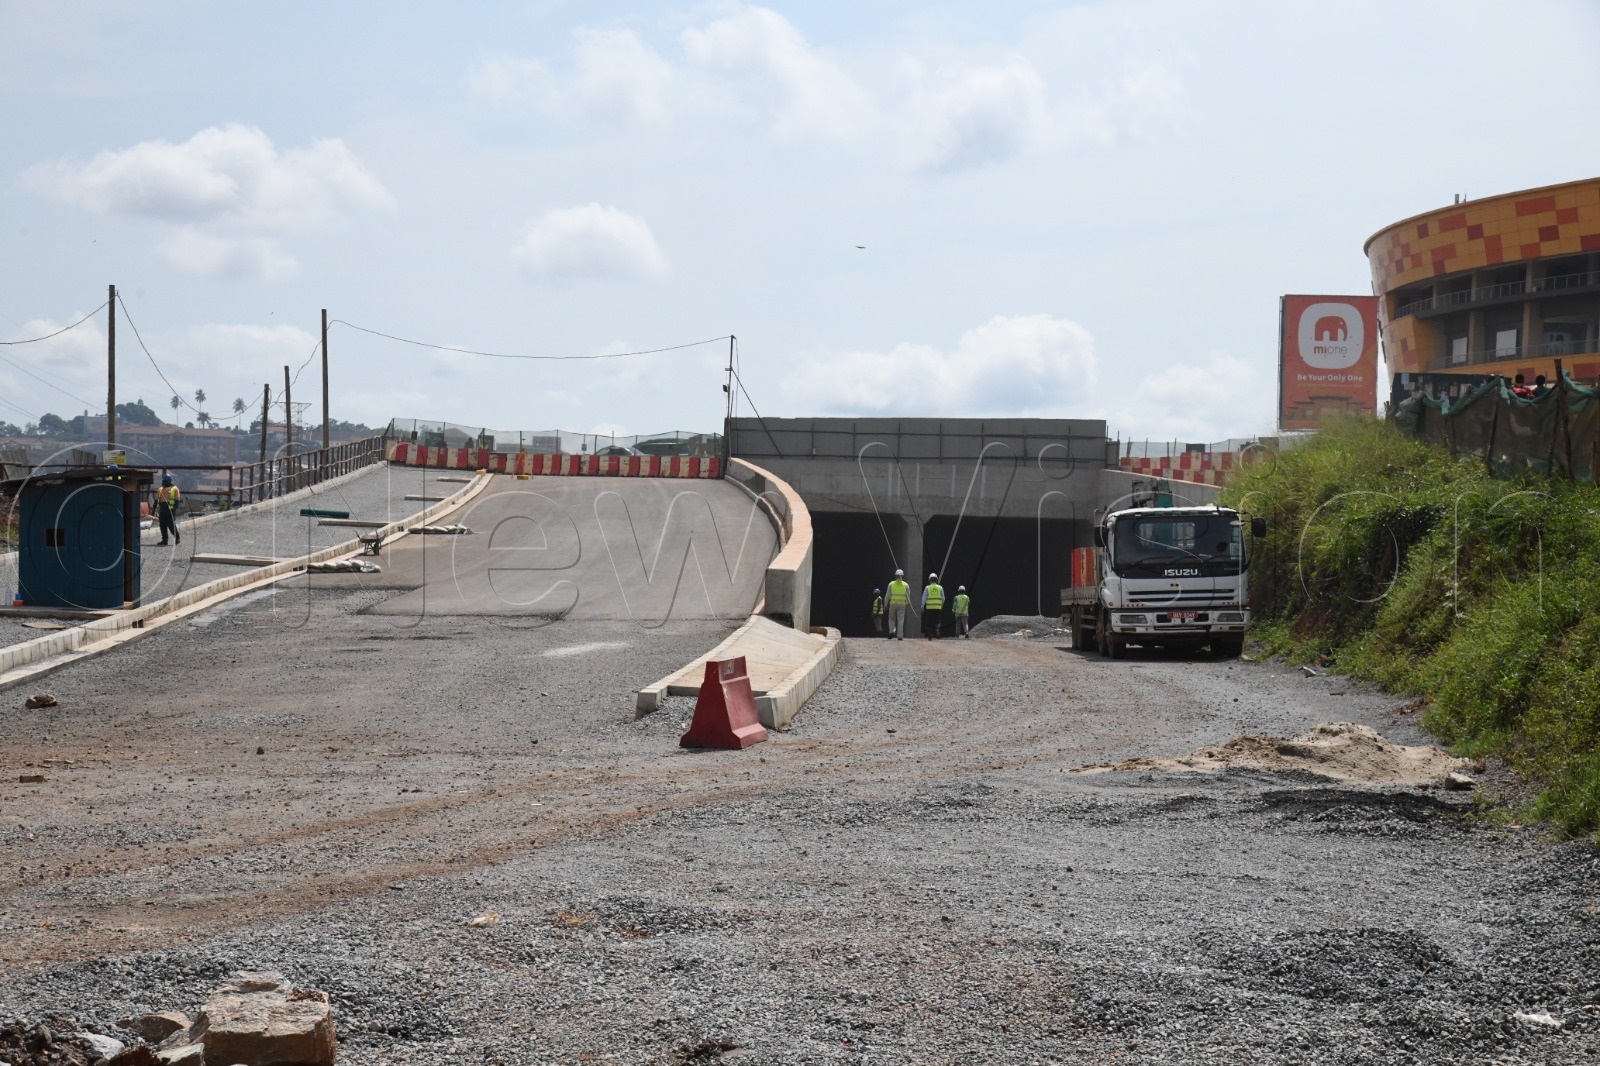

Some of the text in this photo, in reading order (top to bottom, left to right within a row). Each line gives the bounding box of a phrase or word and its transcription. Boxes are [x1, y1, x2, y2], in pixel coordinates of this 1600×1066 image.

[1297, 373, 1307, 381] Be
[1327, 374, 1346, 383] Only
[1347, 374, 1364, 382] One
[1164, 568, 1198, 576] ISUZU
